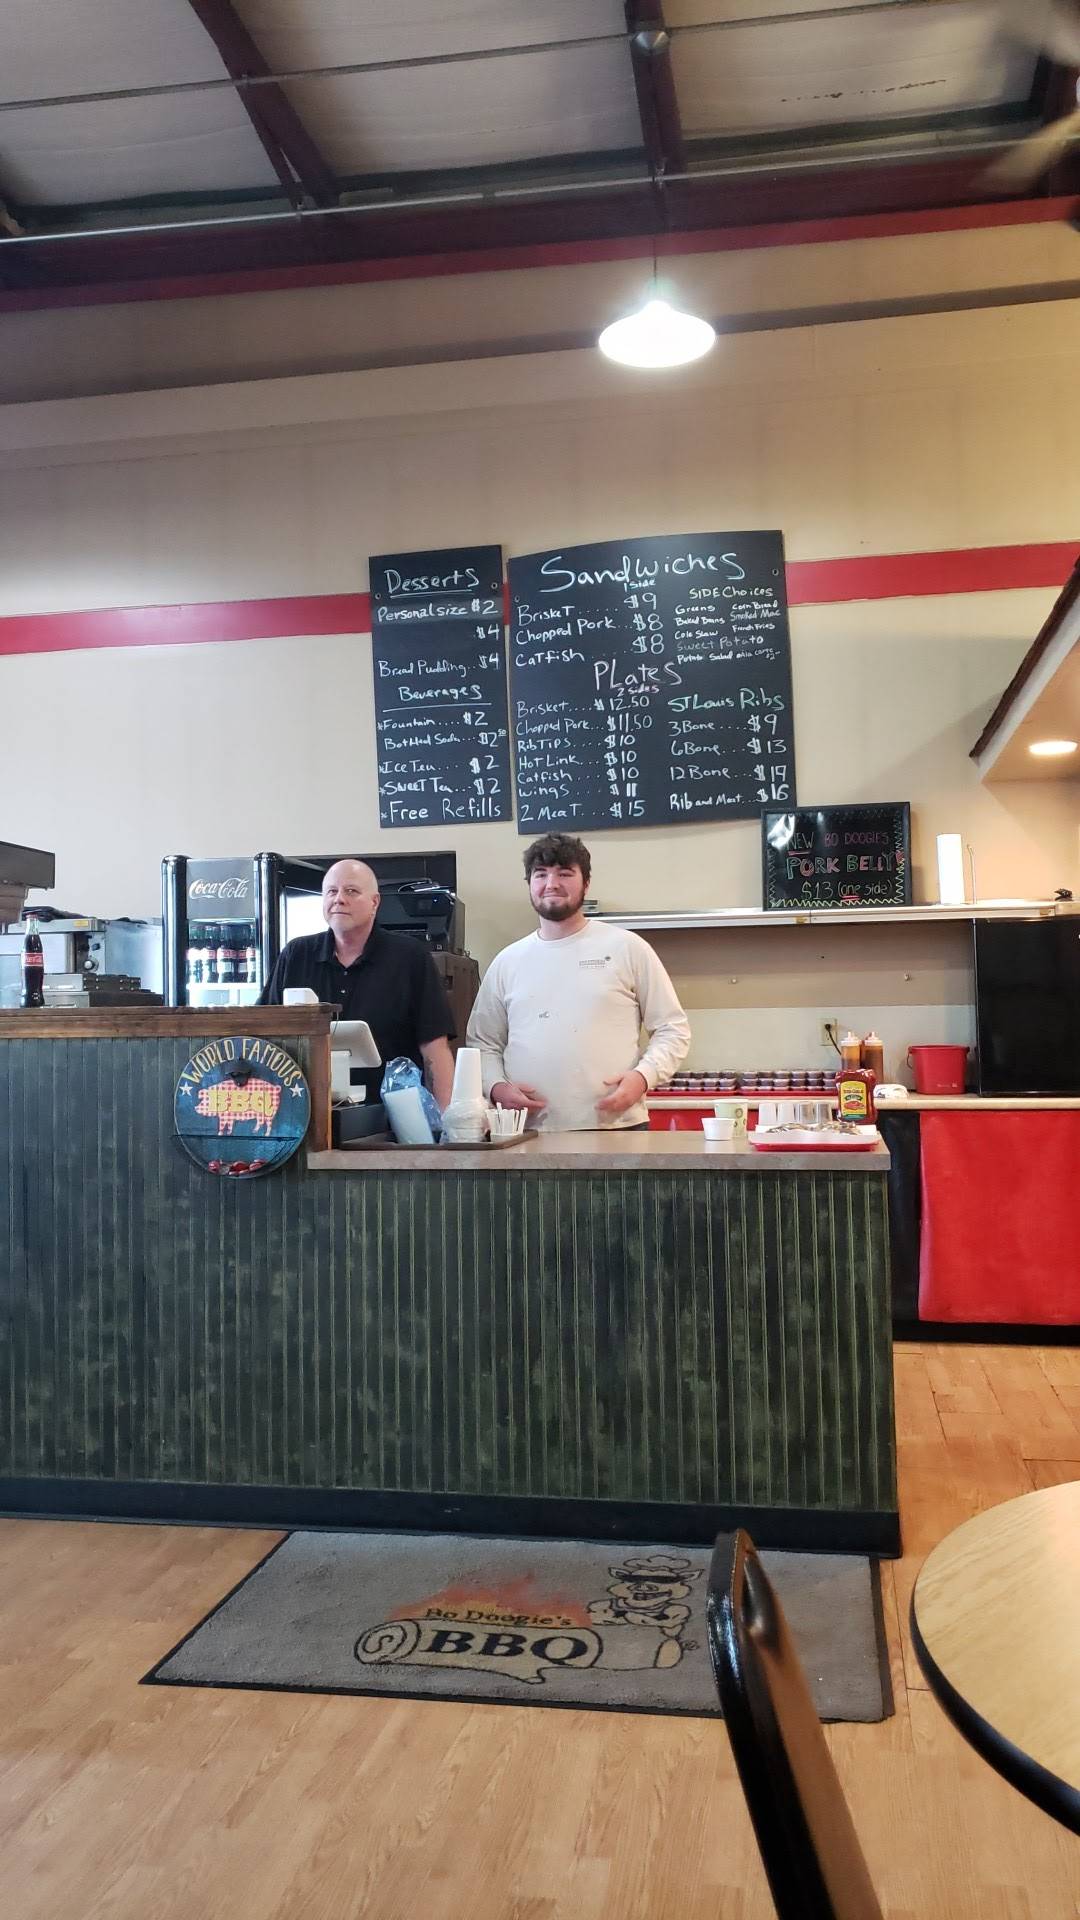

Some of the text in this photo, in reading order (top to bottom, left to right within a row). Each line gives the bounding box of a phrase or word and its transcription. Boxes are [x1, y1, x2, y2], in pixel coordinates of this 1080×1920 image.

[624, 592, 656, 610] $9
[689, 586, 773, 599] SIDE Choices
[471, 598, 499, 615] $2
[675, 604, 715, 615] Greens
[476, 623, 500, 640] $4
[516, 622, 572, 645] Chopped
[633, 613, 663, 631] $8
[632, 634, 664, 655] $8
[478, 652, 499, 670] $4
[739, 687, 785, 711] Ribs
[516, 718, 560, 735] Chopped
[747, 713, 777, 735] $9
[518, 769, 573, 784] Catfish
[390, 797, 501, 823] Free Refills
[669, 792, 692, 811] Rib
[695, 797, 713, 806] and
[520, 805, 534, 822] 2
[786, 851, 894, 879] PORK BELLY
[801, 880, 834, 900] $13
[182, 1038, 302, 1087] WORLD FAMOUS
[425, 1607, 572, 1627] Bo Doogie's
[420, 1628, 588, 1667] BBQ
